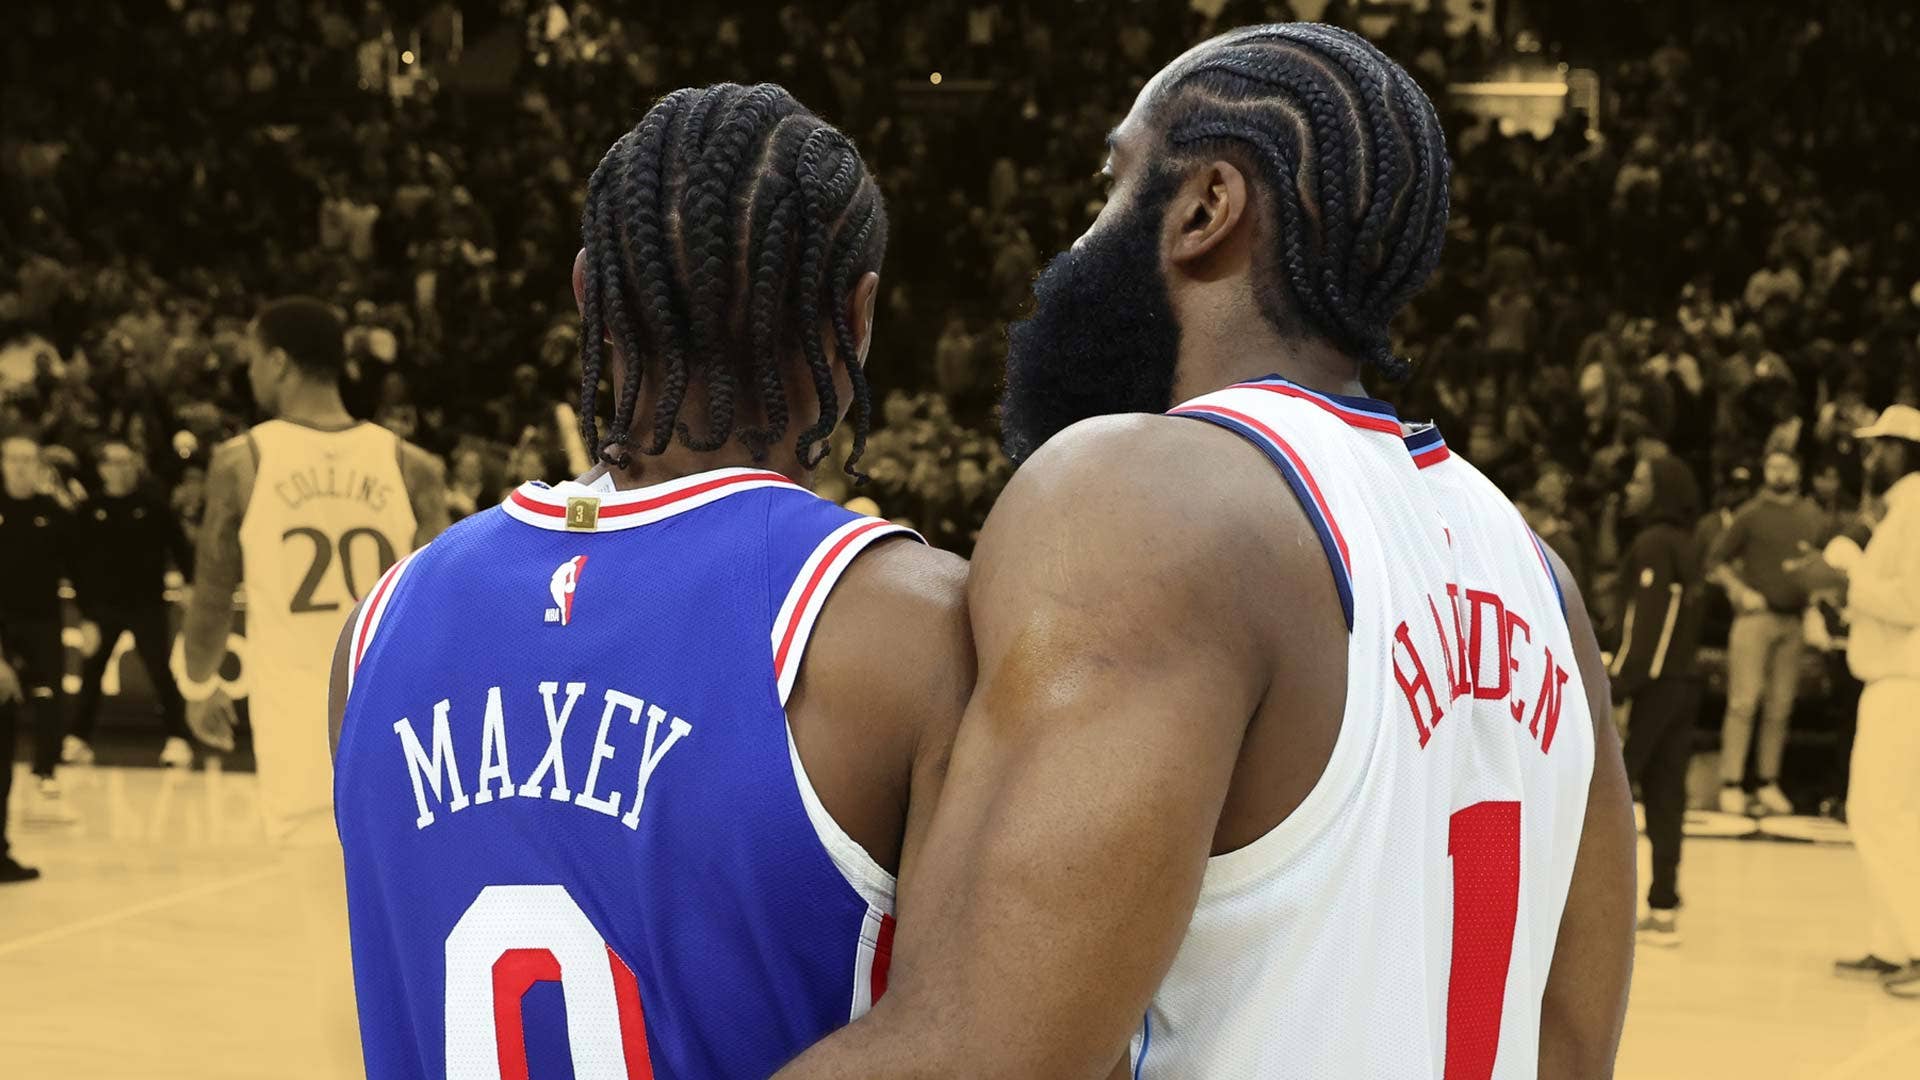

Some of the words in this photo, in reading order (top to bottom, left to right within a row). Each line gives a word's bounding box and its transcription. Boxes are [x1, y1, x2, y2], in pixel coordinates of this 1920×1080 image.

[274, 467, 393, 511] COLLINS
[576, 505, 584, 523] 3
[282, 527, 397, 613] 20
[544, 608, 560, 622] NBA
[393, 682, 692, 830] MAXEY
[445, 884, 655, 1080] 0
[1443, 801, 1521, 1080] 1
